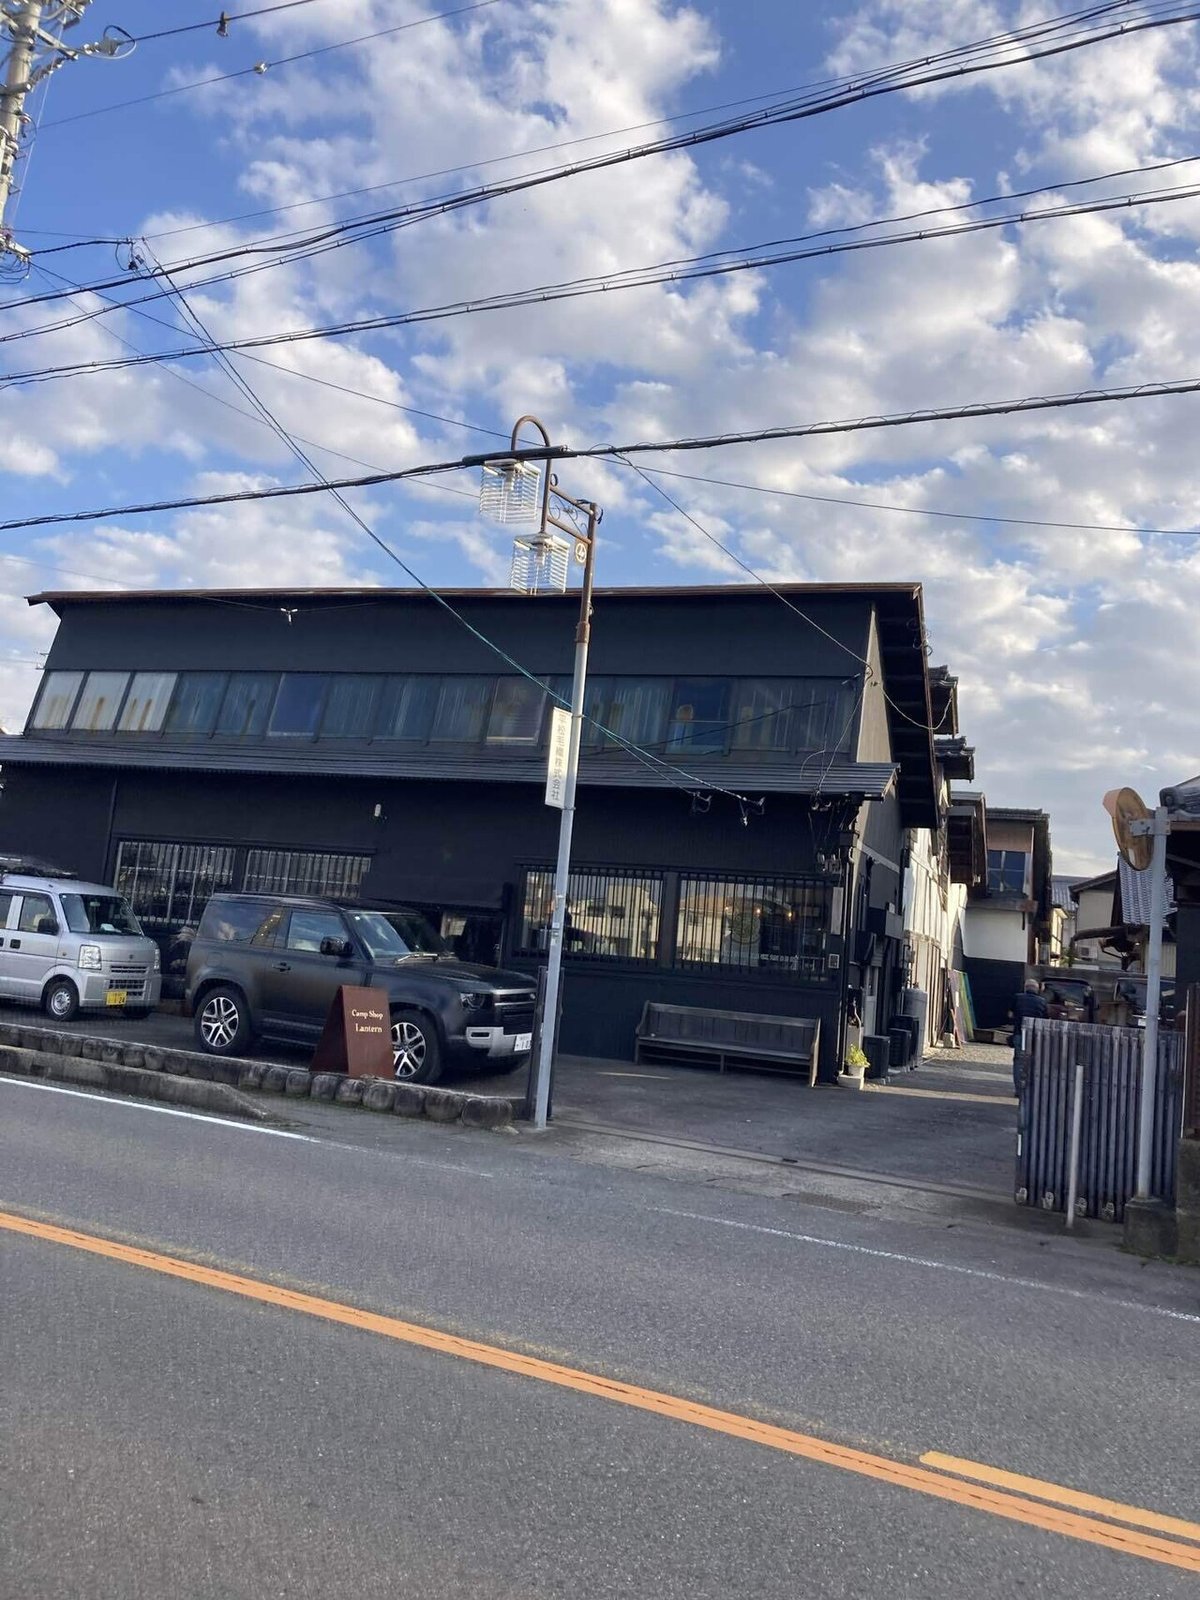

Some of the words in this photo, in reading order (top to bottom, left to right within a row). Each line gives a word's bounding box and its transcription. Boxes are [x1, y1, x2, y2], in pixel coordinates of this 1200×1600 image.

[351, 1008, 368, 1019] Camp
[369, 1010, 384, 1020] Shop
[355, 1023, 383, 1033] Lantern
